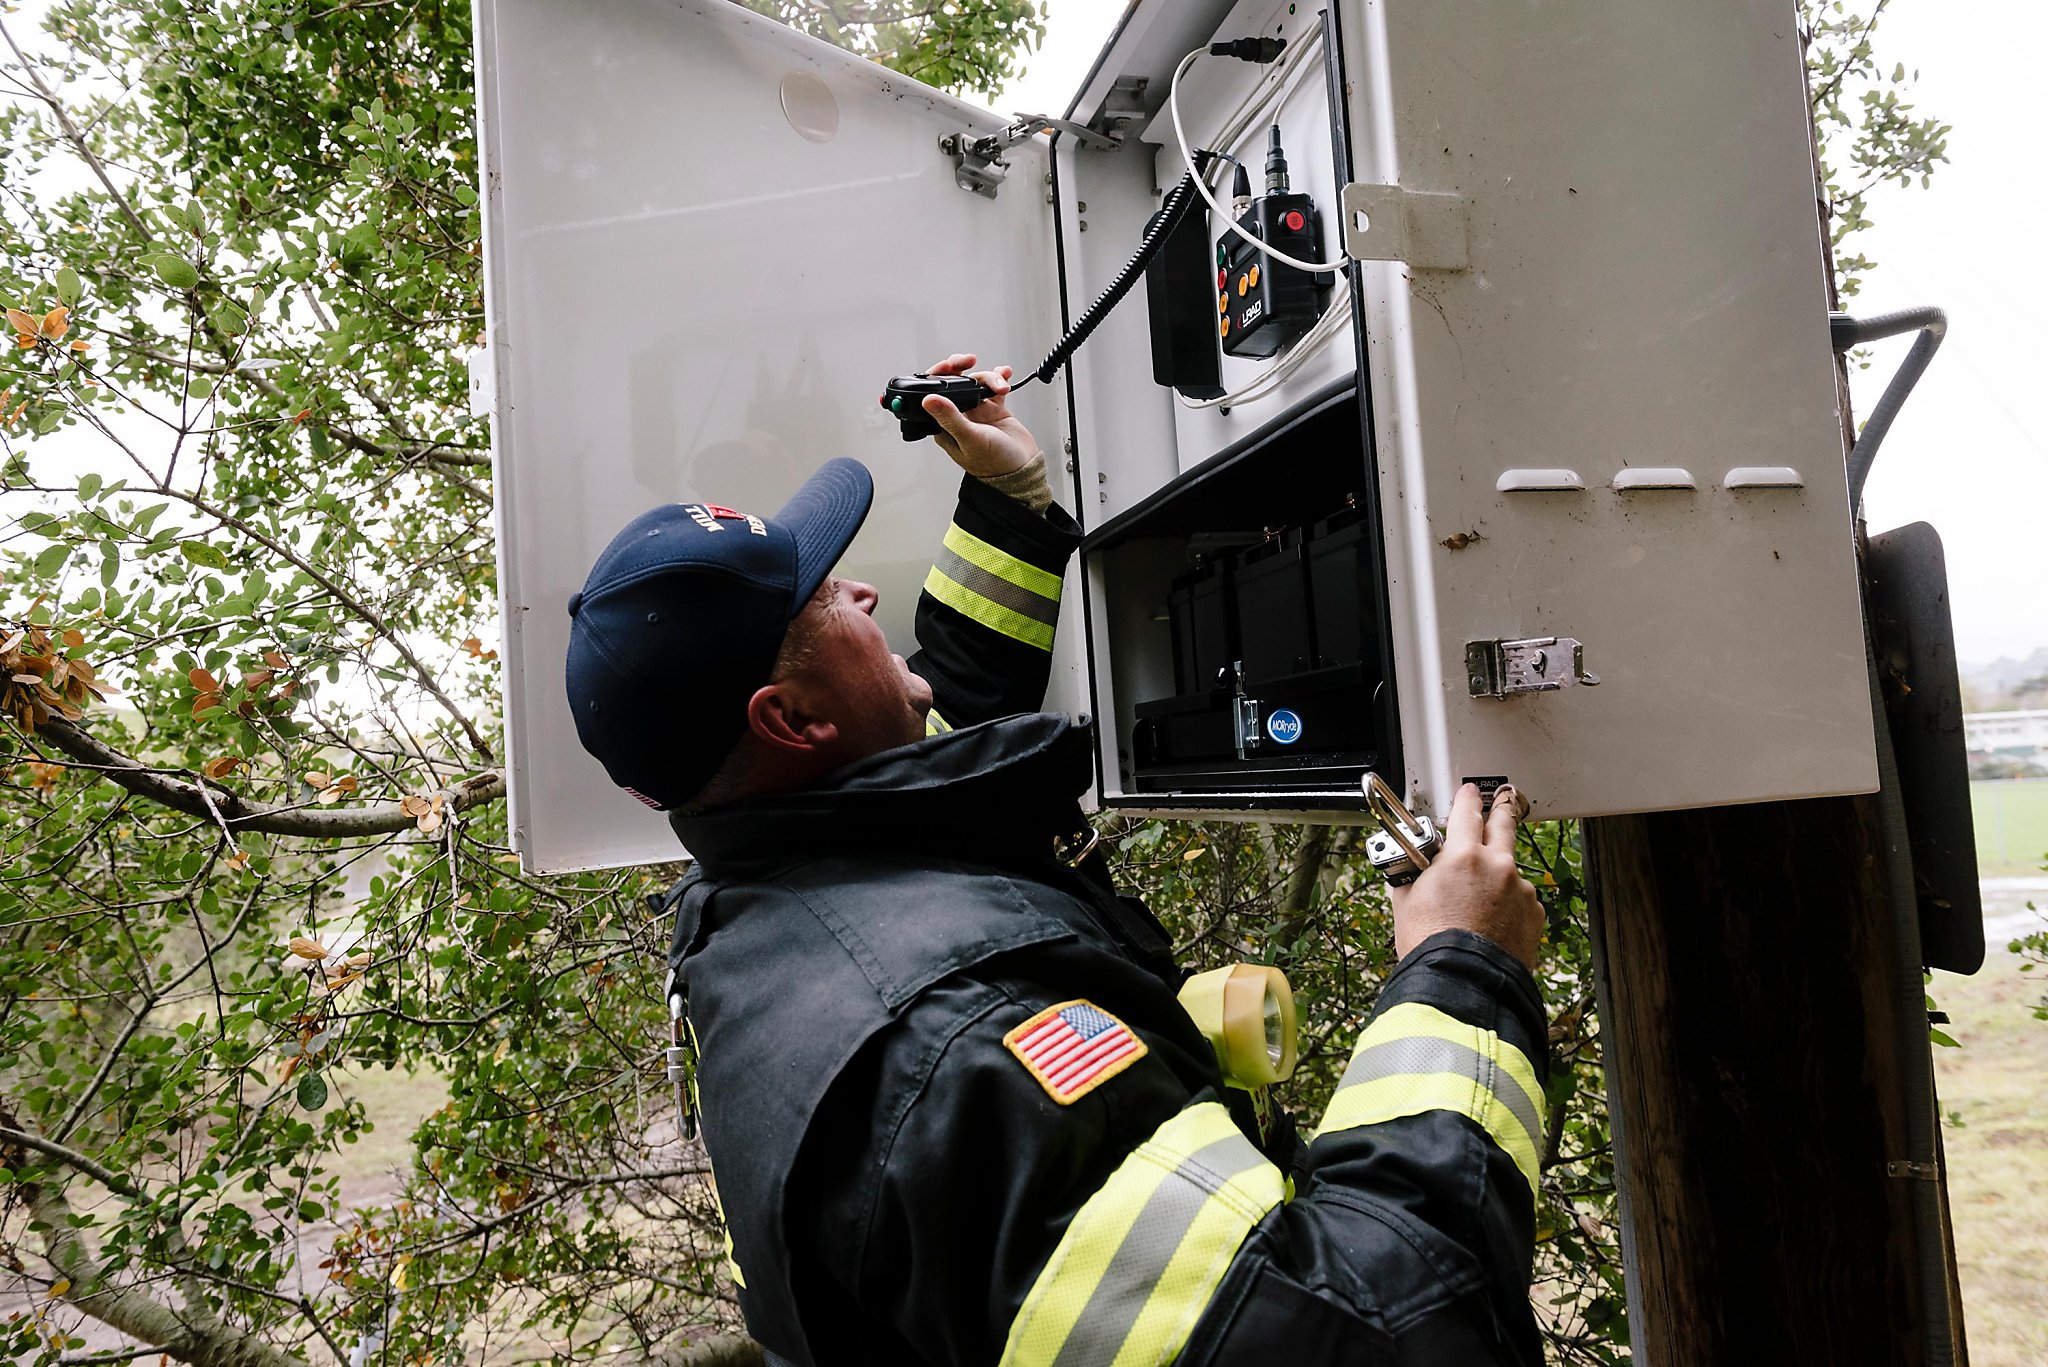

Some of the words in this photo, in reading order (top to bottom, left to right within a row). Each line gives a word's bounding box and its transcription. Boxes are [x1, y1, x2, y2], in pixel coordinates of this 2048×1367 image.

[1242, 299, 1262, 323] LRAD
[685, 505, 725, 532] MILL
[1475, 780, 1499, 788] LRAD
